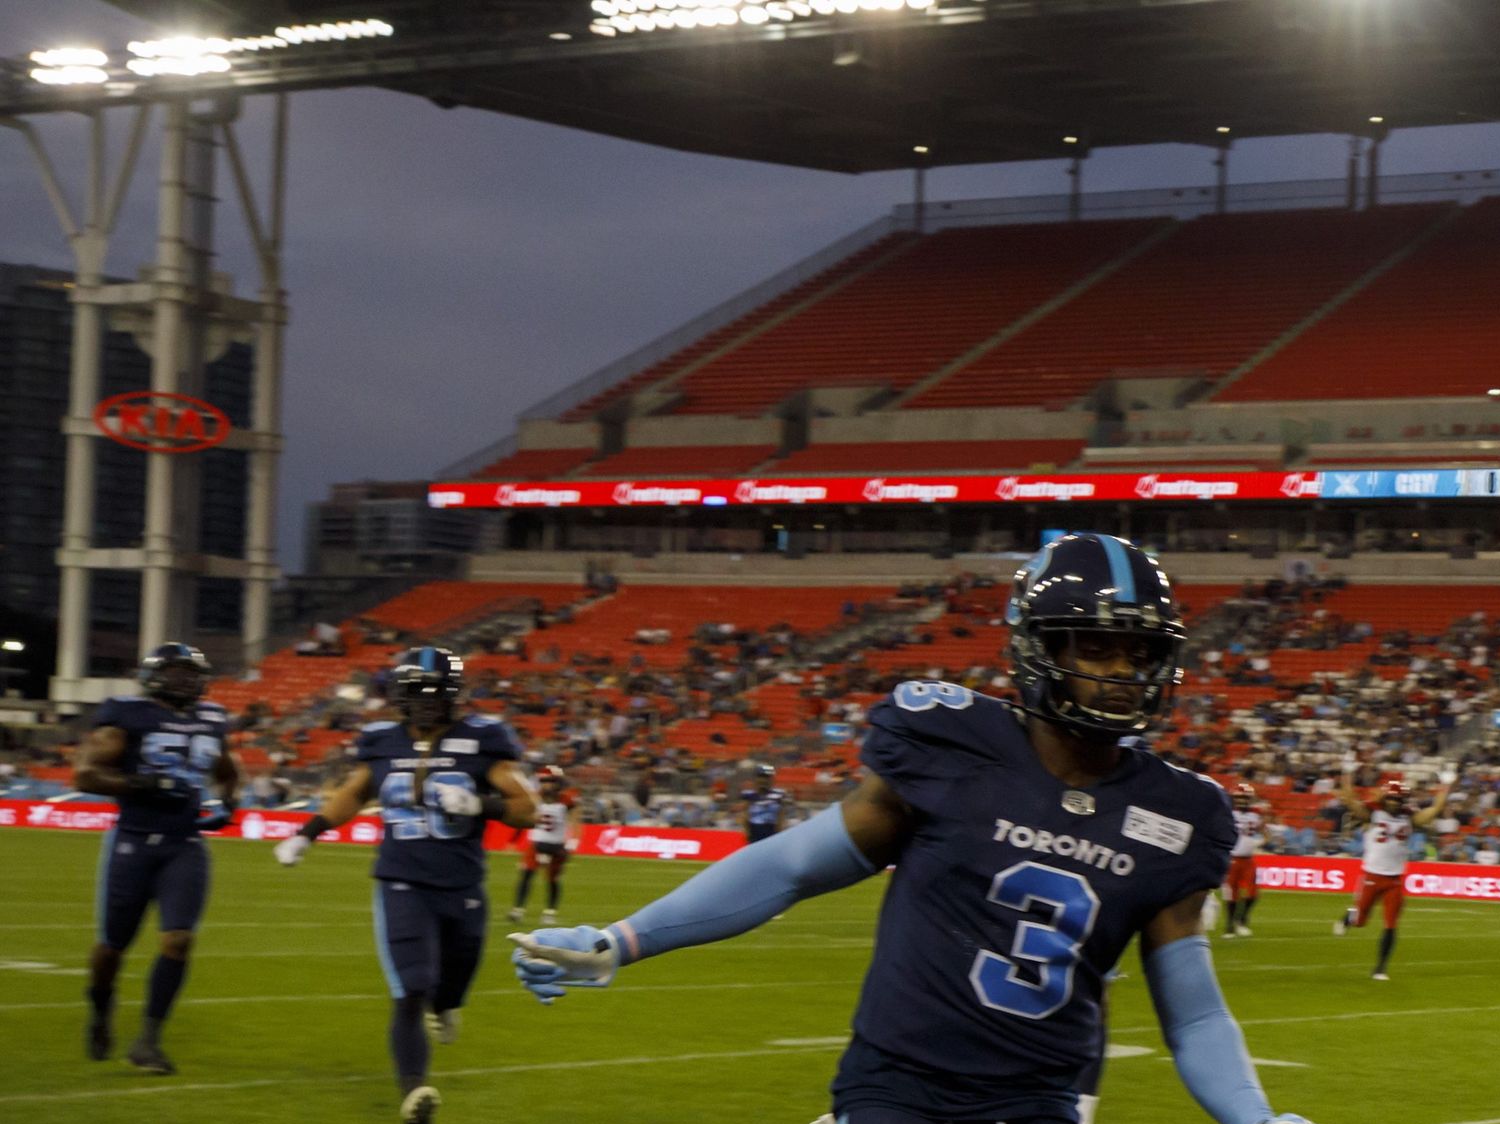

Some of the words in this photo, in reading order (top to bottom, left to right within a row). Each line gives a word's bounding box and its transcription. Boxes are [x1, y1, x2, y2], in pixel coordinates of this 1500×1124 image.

[119, 404, 206, 438] KIA
[993, 819, 1135, 876] TORONTO
[969, 861, 1100, 1020] 3
